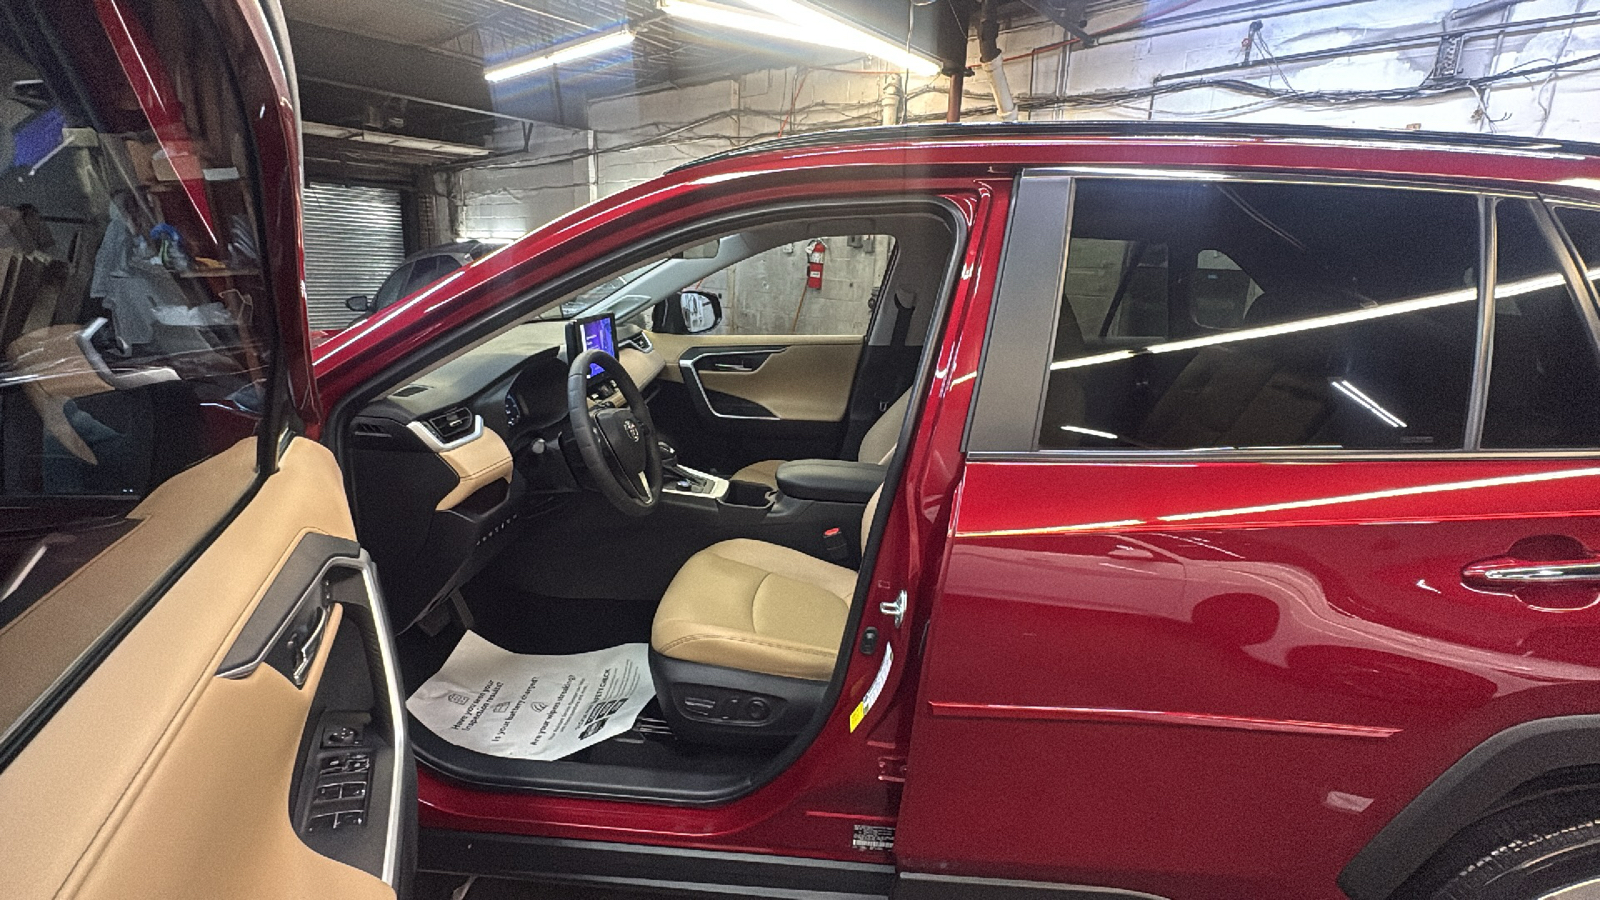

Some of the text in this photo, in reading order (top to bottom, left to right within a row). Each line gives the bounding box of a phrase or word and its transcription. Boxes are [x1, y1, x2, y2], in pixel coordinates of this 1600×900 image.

[452, 680, 494, 730] Have you seen your
[497, 721, 511, 735] your
[504, 700, 526, 721] battery
[530, 734, 543, 746] Are
[538, 720, 550, 734] your
[557, 674, 576, 701] streaking?
